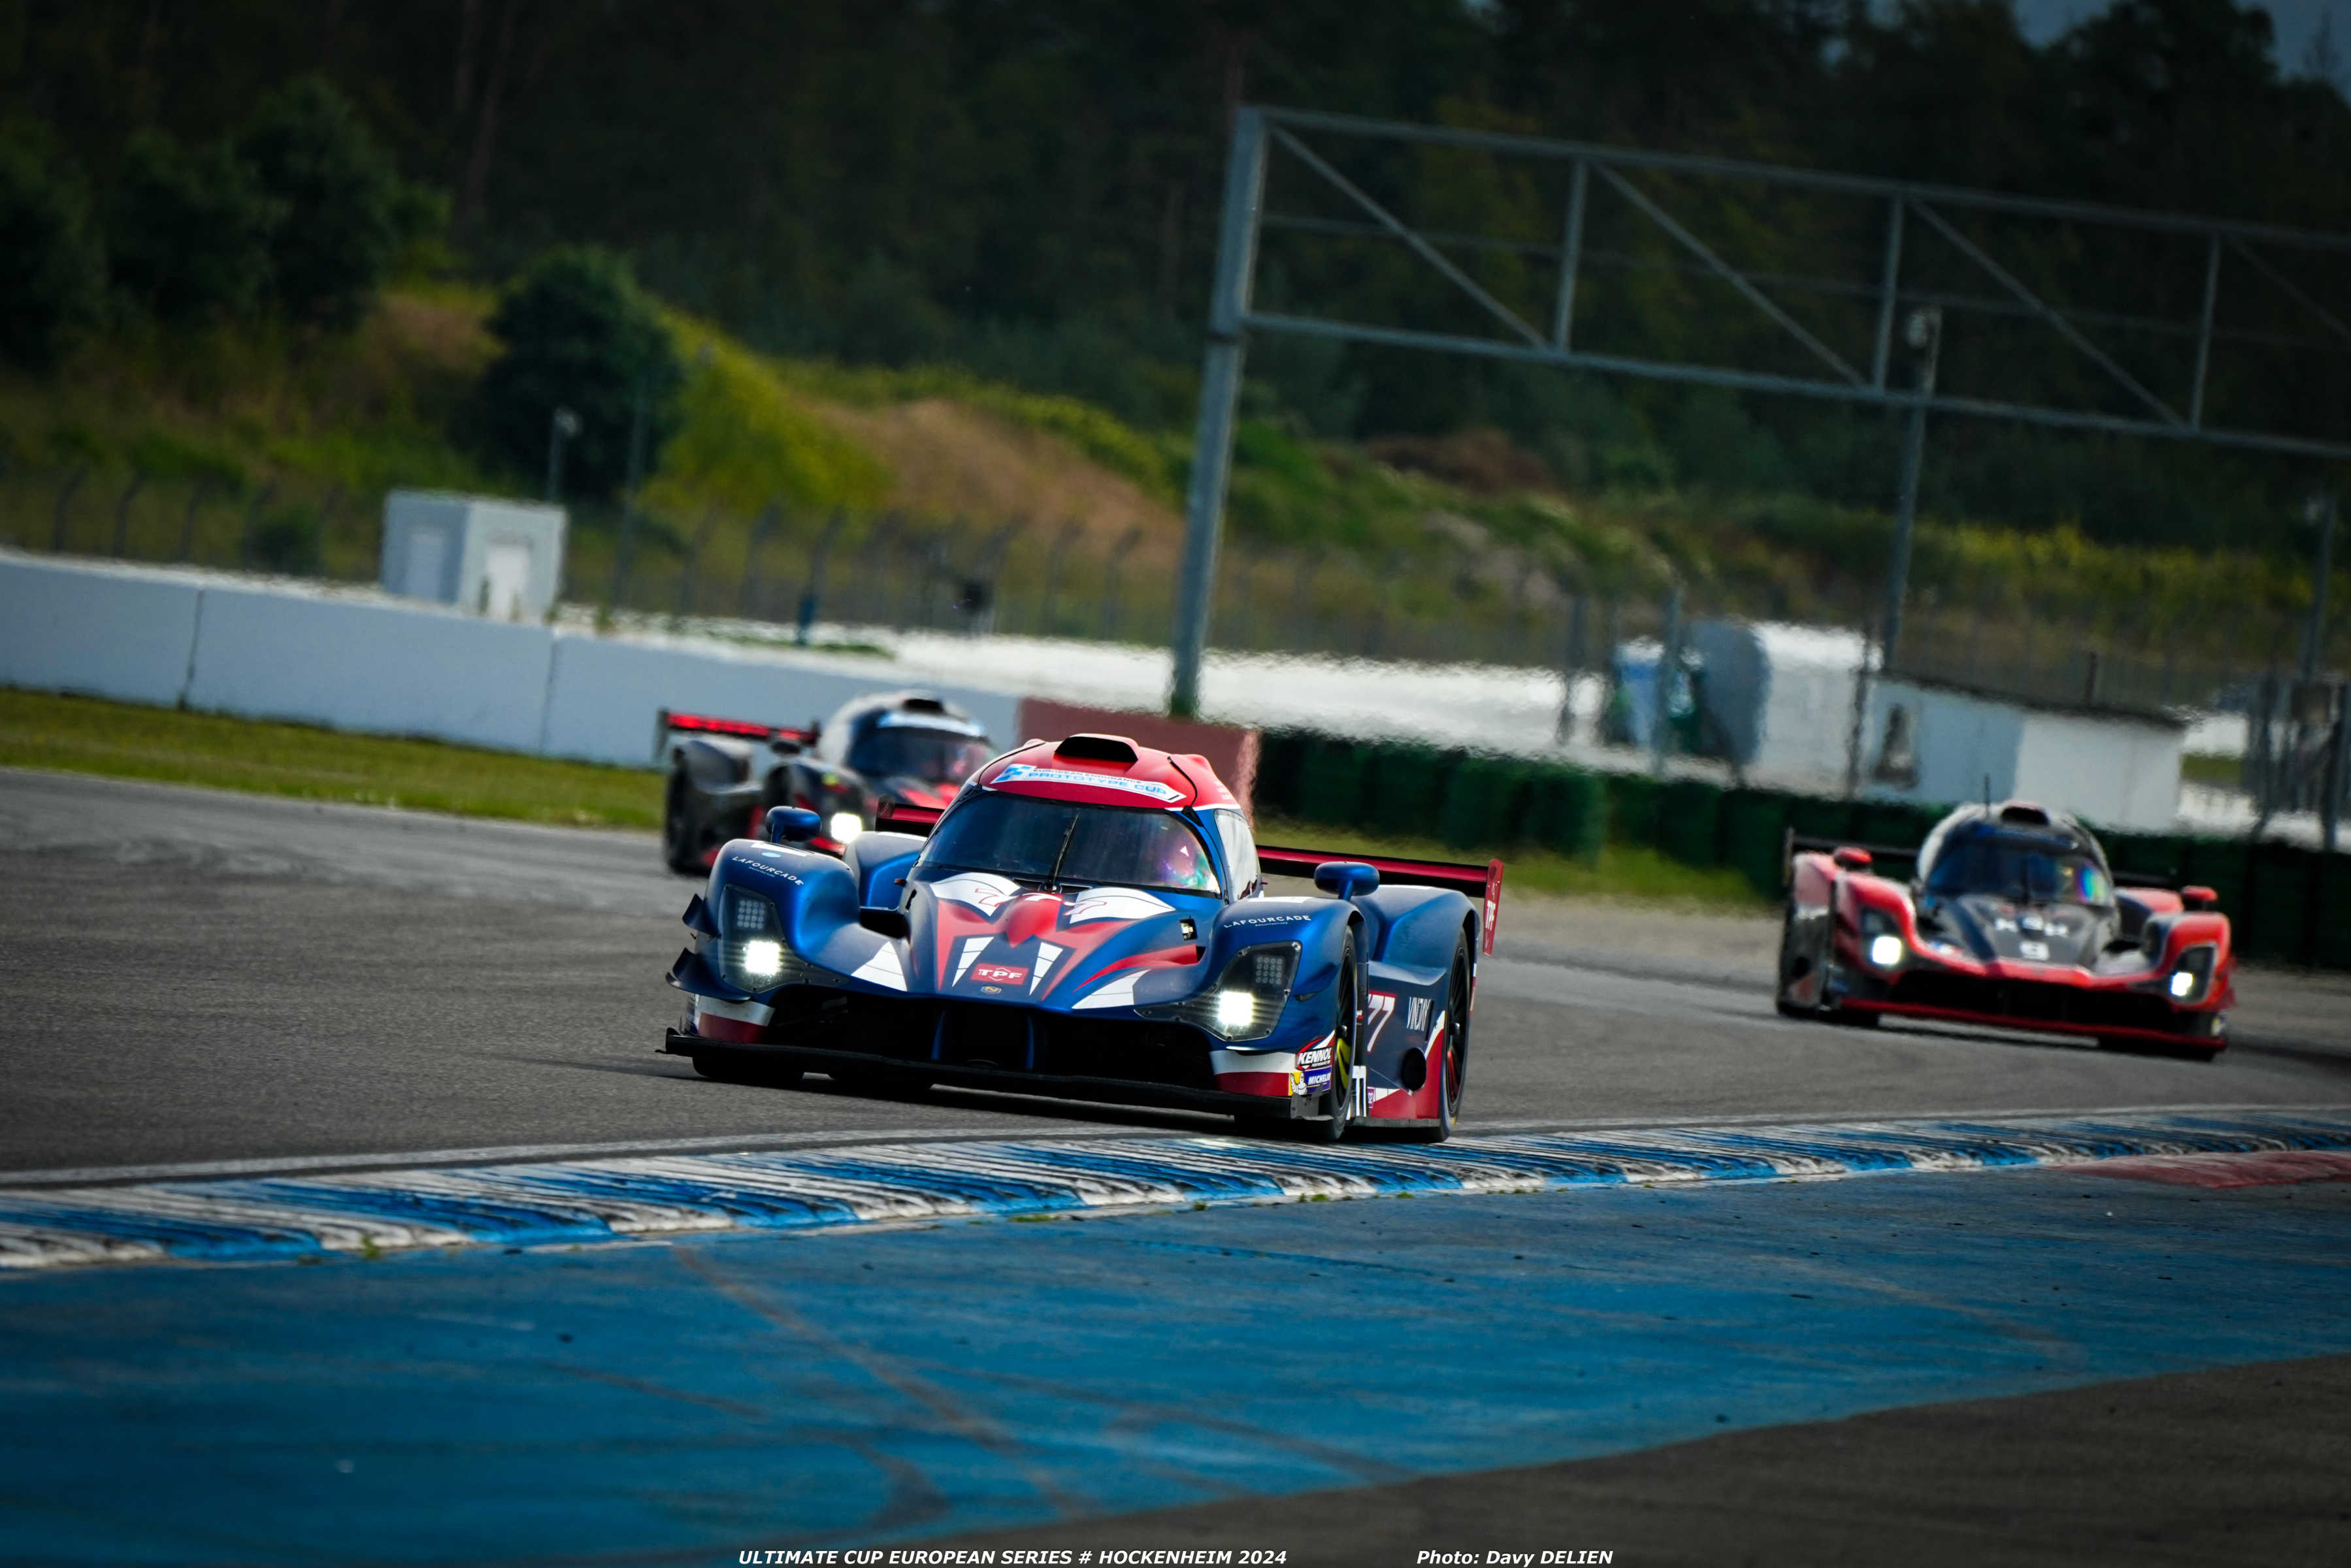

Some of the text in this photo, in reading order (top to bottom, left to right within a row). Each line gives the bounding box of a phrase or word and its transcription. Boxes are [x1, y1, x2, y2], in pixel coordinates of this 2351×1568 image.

[1028, 772, 1166, 794] PROTOTYPE CUP
[731, 856, 804, 886] LAFOURCADE
[1223, 915, 1311, 928] LAFOURCADE
[978, 968, 1023, 979] TPF
[1367, 994, 1396, 1053] 77
[1297, 1047, 1332, 1065] KENNOL
